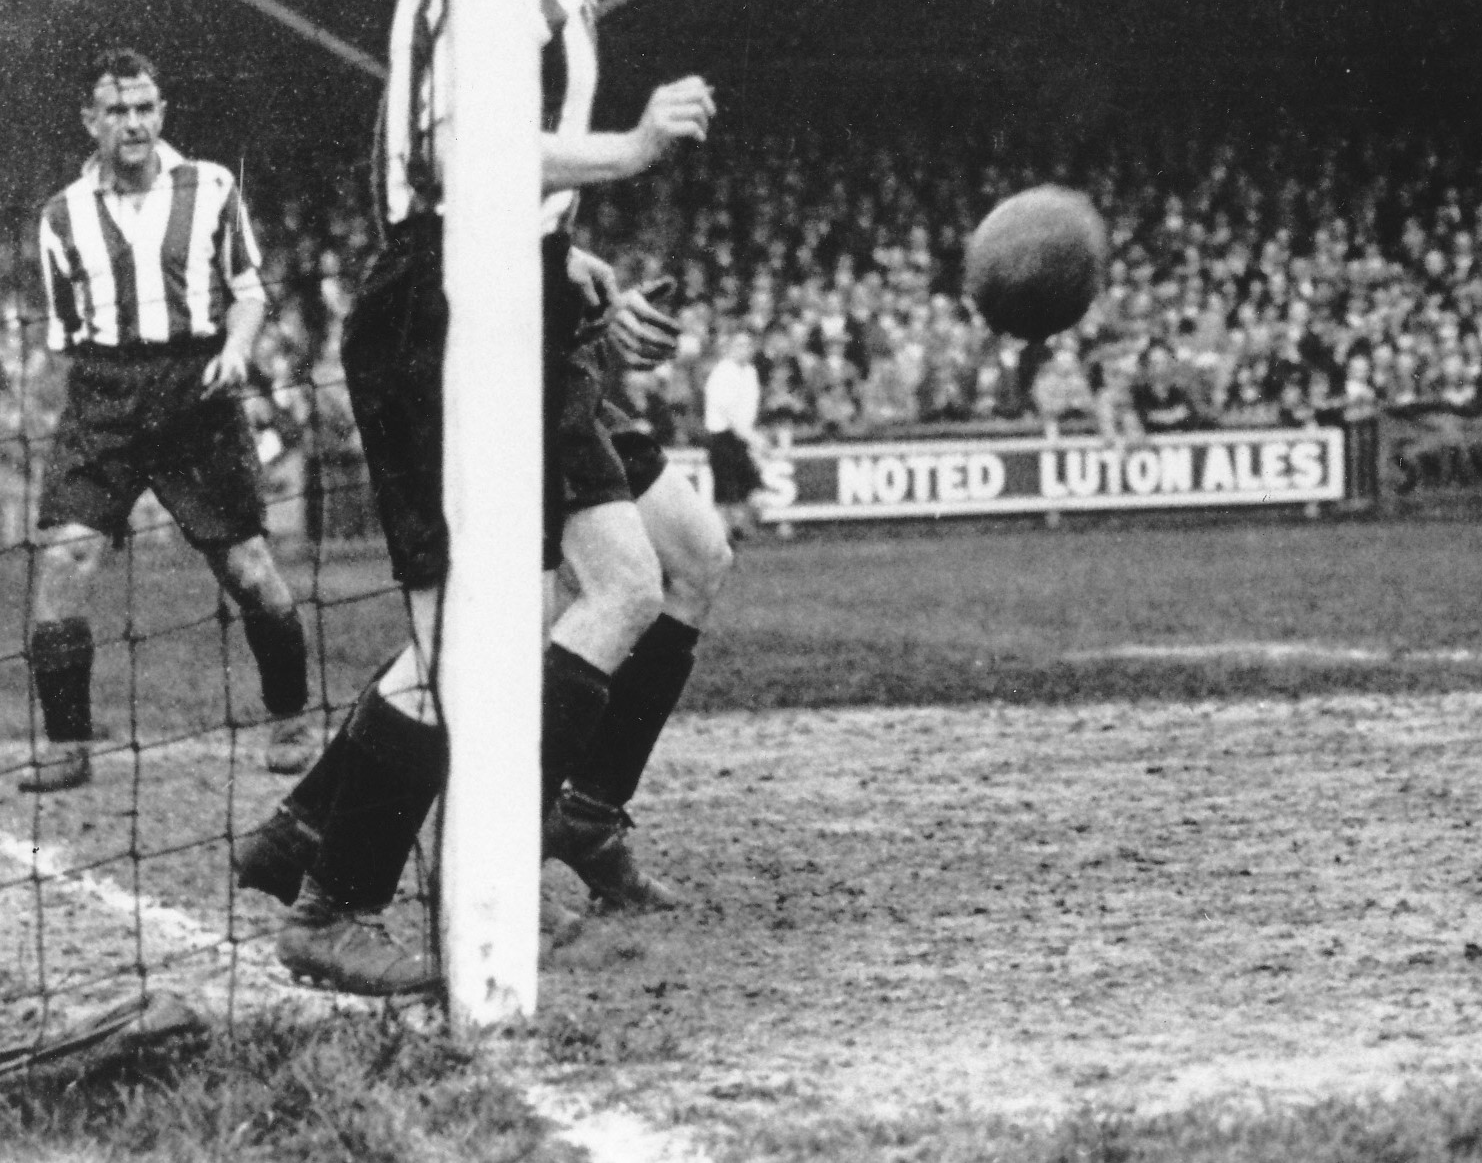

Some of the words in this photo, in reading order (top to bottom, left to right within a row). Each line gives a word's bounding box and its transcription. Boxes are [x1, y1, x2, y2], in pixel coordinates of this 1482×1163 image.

[838, 454, 1005, 505] NOTED
[1041, 448, 1194, 497] LUTON
[1203, 442, 1325, 493] ALES
